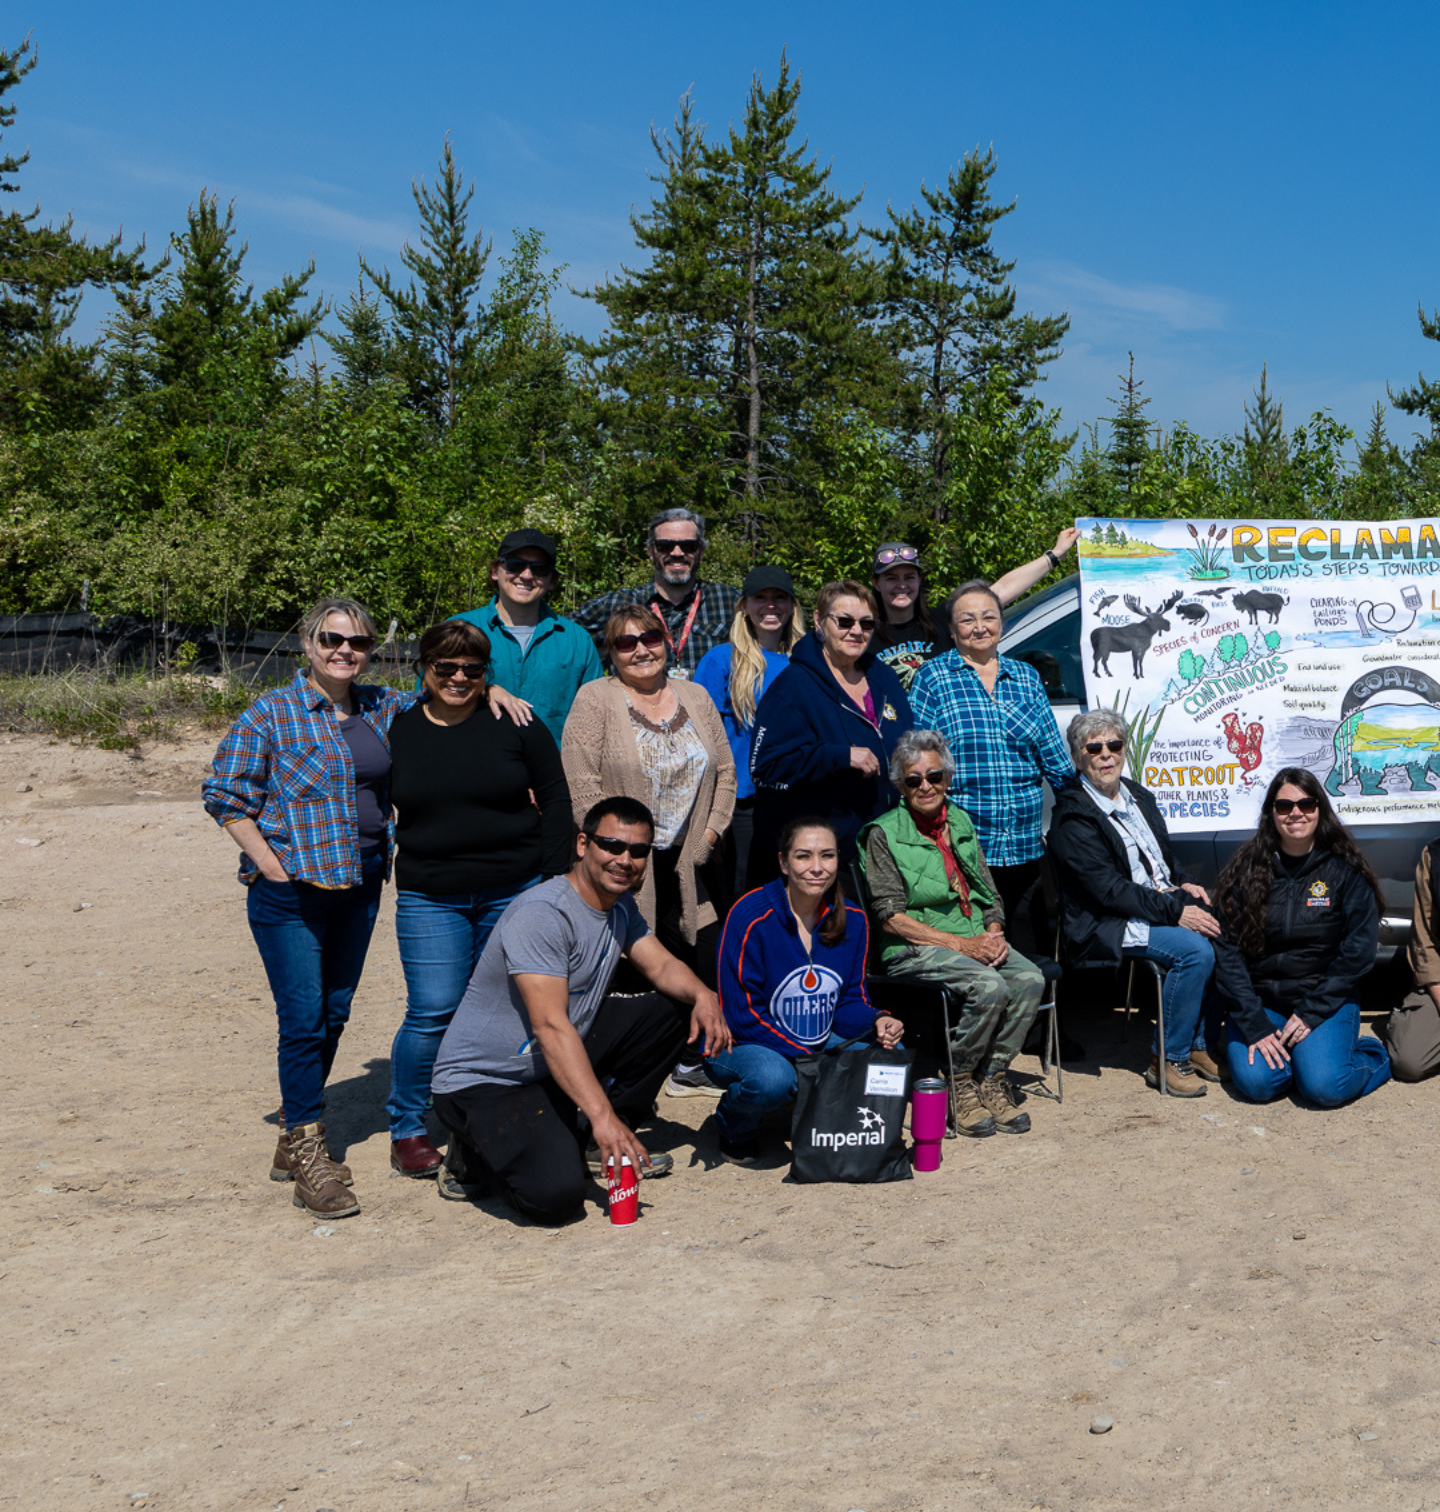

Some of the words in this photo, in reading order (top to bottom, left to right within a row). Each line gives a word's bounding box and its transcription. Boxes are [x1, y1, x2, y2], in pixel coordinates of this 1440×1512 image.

[1241, 562, 1313, 581] TODAY'S
[1322, 562, 1369, 576] STEPS
[1089, 588, 1106, 605] FISH
[1102, 614, 1131, 625] MOOSE
[1314, 616, 1347, 627] PONDS
[1152, 636, 1188, 657] SPECIES
[1200, 619, 1240, 639] CONCERN
[876, 640, 934, 662] CALGARY
[1183, 656, 1288, 715] CONTINUOUS
[1353, 668, 1430, 698] GOALS
[1193, 692, 1243, 723] MONITORING
[1283, 700, 1298, 708] Soil
[1299, 700, 1326, 711] quality
[1153, 740, 1166, 749] The
[1168, 738, 1211, 750] importance
[1150, 750, 1214, 764] PROTECTING
[1145, 763, 1241, 787] RATROOT
[1158, 790, 1184, 801] OTHER
[1187, 789, 1219, 801] PLANTS
[1221, 788, 1229, 800] &
[1157, 800, 1231, 818] SPECIES
[1337, 803, 1381, 815] Indigenous
[1383, 802, 1425, 813] performance
[782, 991, 836, 1016] OILERS
[811, 1125, 885, 1152] Imperial
